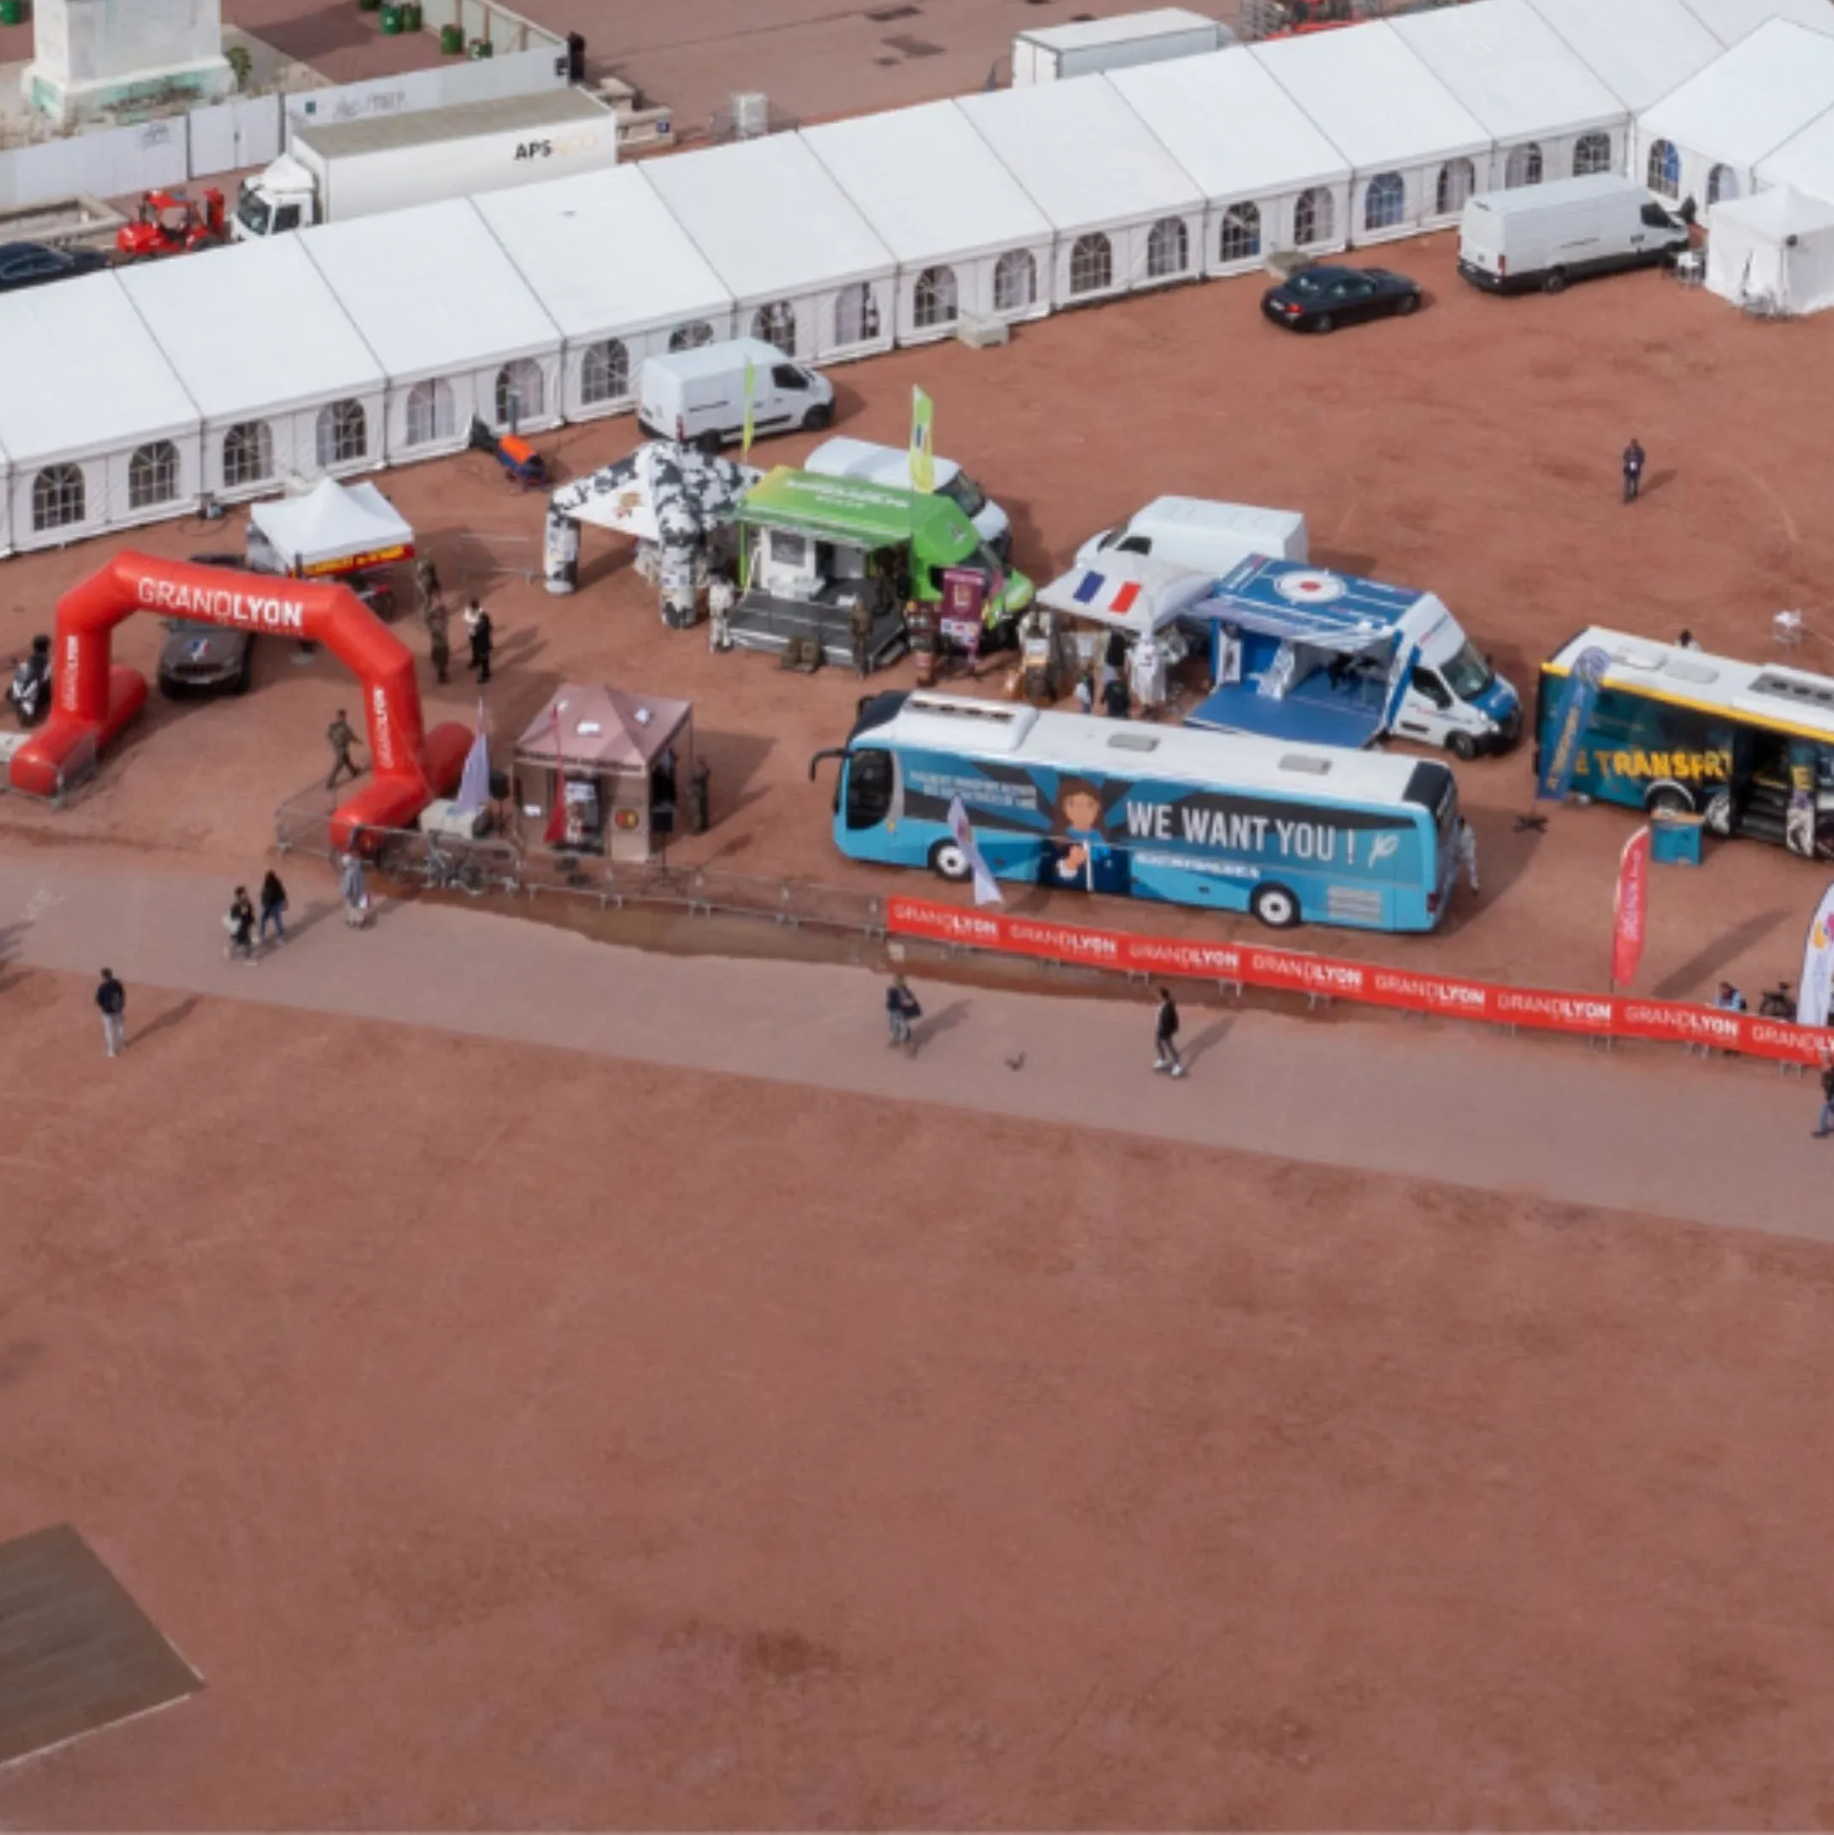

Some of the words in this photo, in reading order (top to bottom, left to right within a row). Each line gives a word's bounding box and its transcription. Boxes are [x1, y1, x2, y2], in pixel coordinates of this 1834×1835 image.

[138, 577, 304, 627] GRANDLYON
[1127, 800, 1173, 841] WE
[1181, 806, 1269, 853] WANT
[1275, 818, 1336, 863] YOU
